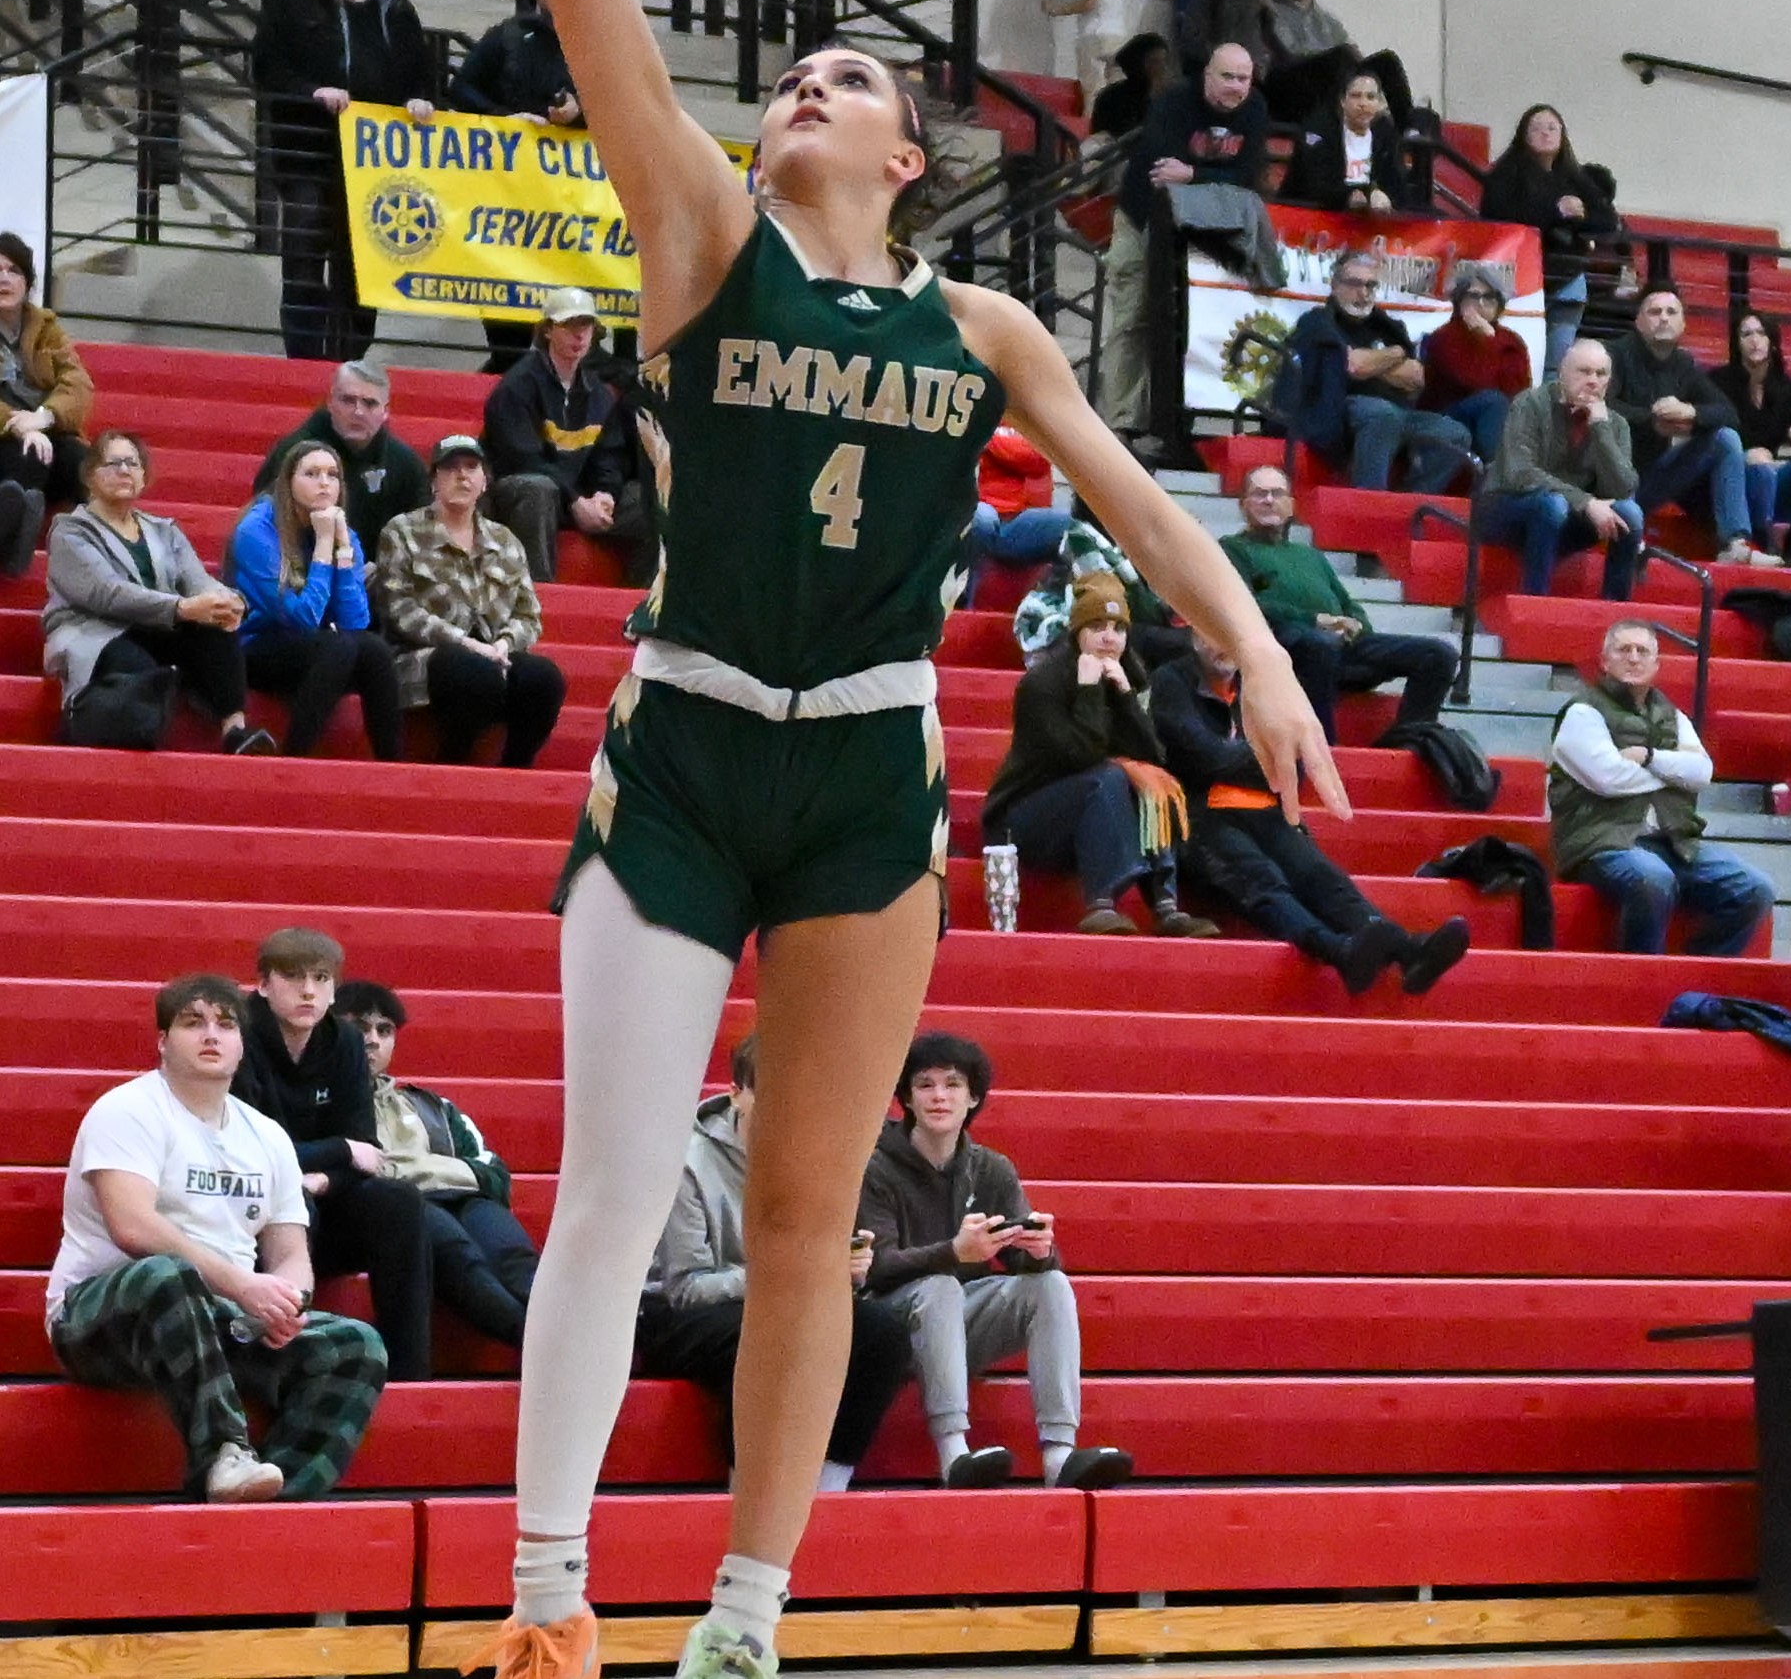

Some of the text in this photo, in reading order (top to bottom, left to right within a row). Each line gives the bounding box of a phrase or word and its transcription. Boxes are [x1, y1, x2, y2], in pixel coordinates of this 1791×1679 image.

[354, 117, 606, 182] ROTARY CLU
[463, 205, 600, 253] SERVICE
[410, 277, 547, 308] SERVING TH
[713, 338, 986, 438] EMMAUS
[809, 442, 866, 550] 4
[185, 1168, 264, 1198] FOOBALL
